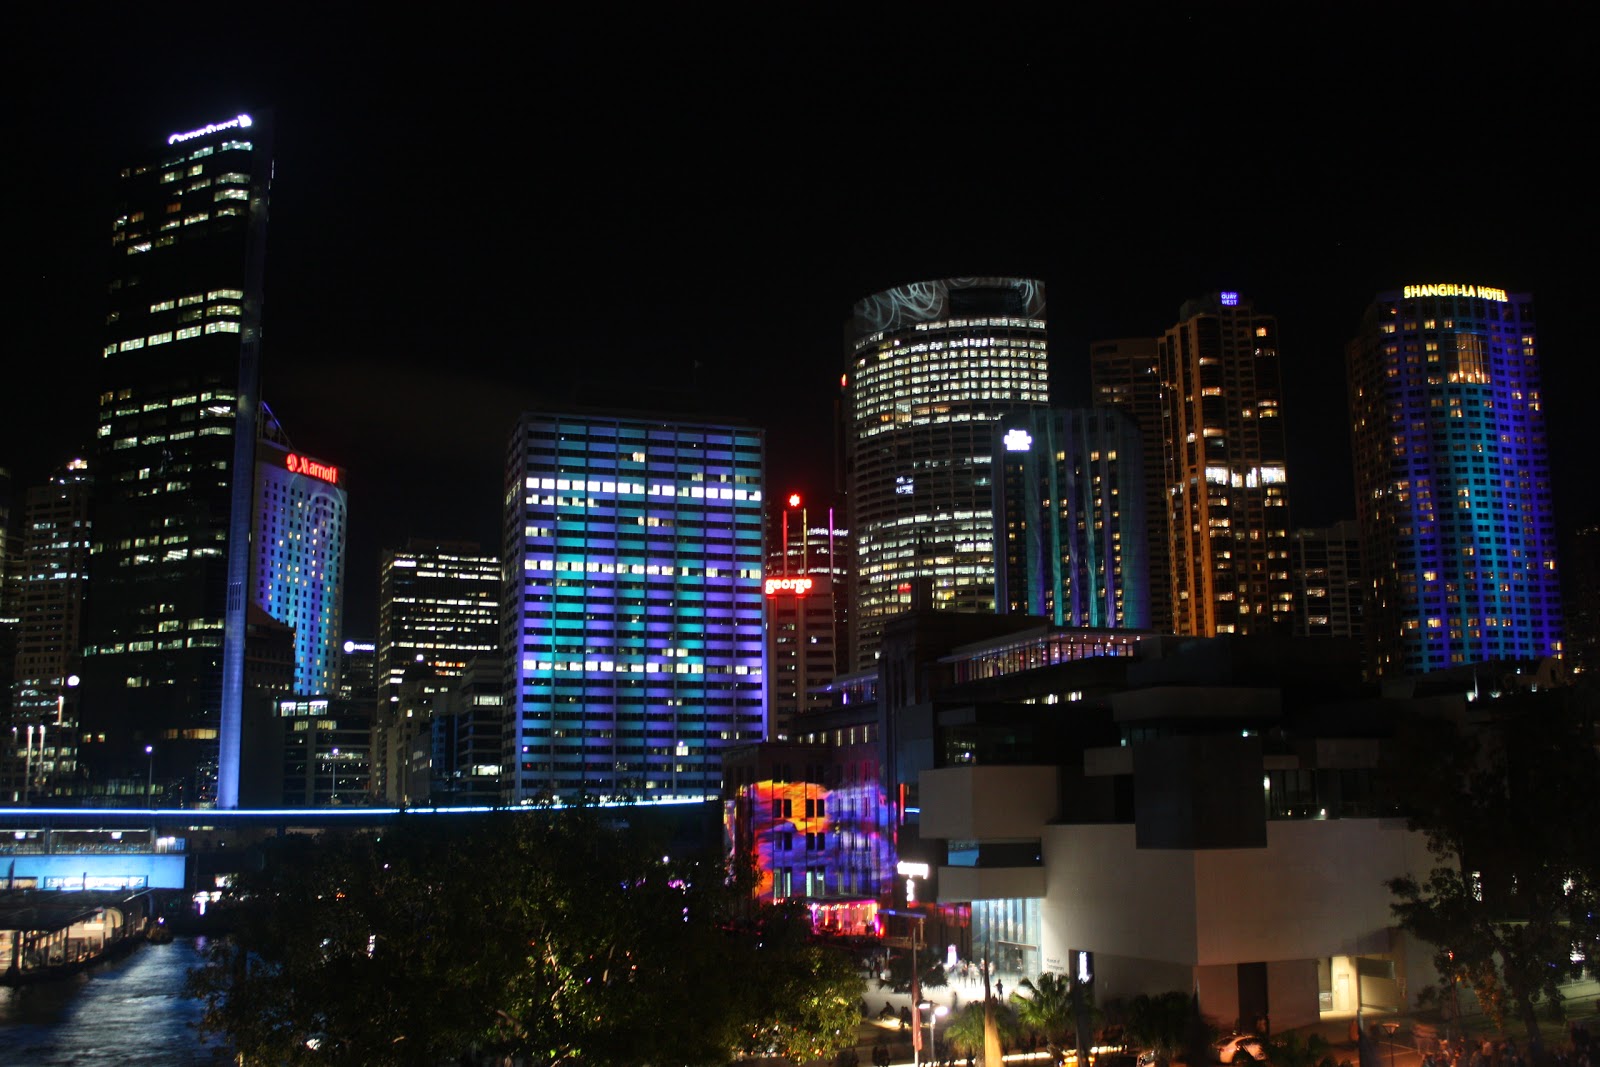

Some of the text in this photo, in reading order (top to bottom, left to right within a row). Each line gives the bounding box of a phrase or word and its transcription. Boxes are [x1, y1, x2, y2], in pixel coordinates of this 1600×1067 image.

[1221, 292, 1237, 300] QUAY
[1403, 283, 1508, 302] SHANGRI-LA HOTEL
[297, 456, 337, 483] Marriott
[765, 578, 812, 594] george
